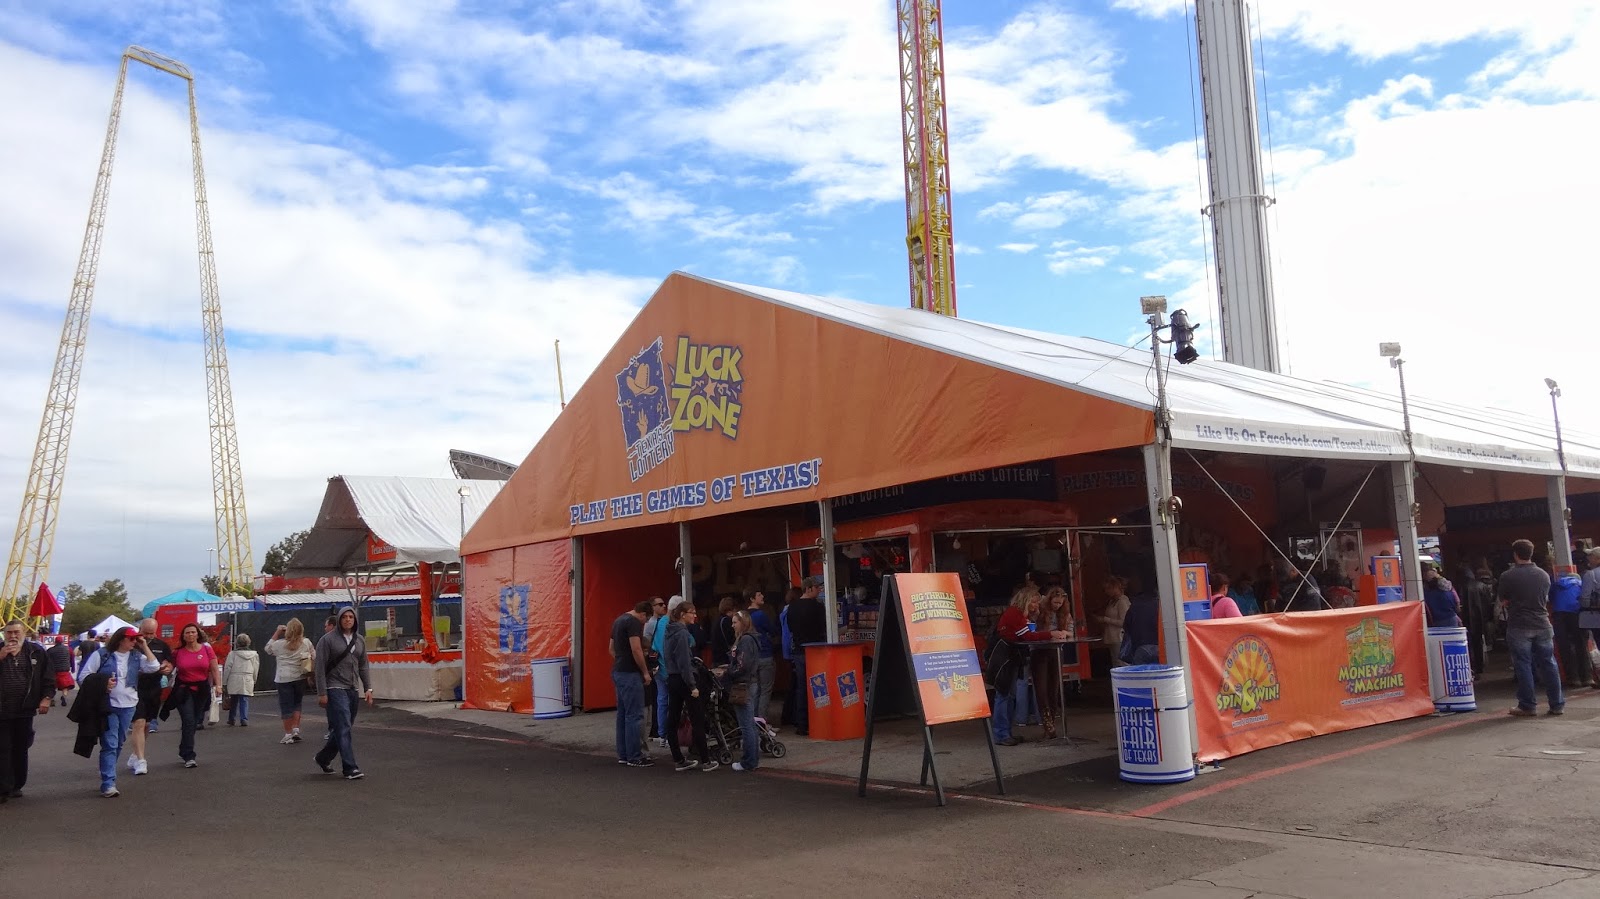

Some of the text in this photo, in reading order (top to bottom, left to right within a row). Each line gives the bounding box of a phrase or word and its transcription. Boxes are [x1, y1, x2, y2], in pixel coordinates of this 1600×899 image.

[674, 336, 743, 387] LUCK
[671, 387, 742, 439] ZONE
[635, 427, 664, 457] TEXAS
[1196, 425, 1392, 453] Like Us On Facebook.com/TexasLottery
[629, 430, 675, 482] LOTTERY
[991, 468, 1040, 482] LOTTERY
[570, 459, 820, 525] PLAY THE GAMES OF TEXAS!
[911, 591, 956, 602] BIG THRILLS
[914, 600, 956, 611] BIG PRIZES
[197, 603, 249, 611] COUPONS
[911, 609, 963, 622] BIG WINNERS
[1446, 654, 1469, 669] STATE
[953, 672, 968, 682] LUCK
[1339, 664, 1379, 681] MONEY
[1354, 673, 1404, 693] MACHINE
[1216, 692, 1242, 711] SPIN
[1254, 683, 1280, 701] WIN!
[1120, 706, 1153, 726] STATE
[1121, 726, 1156, 749] FAIR
[1124, 749, 1157, 763] OF TEXAS
